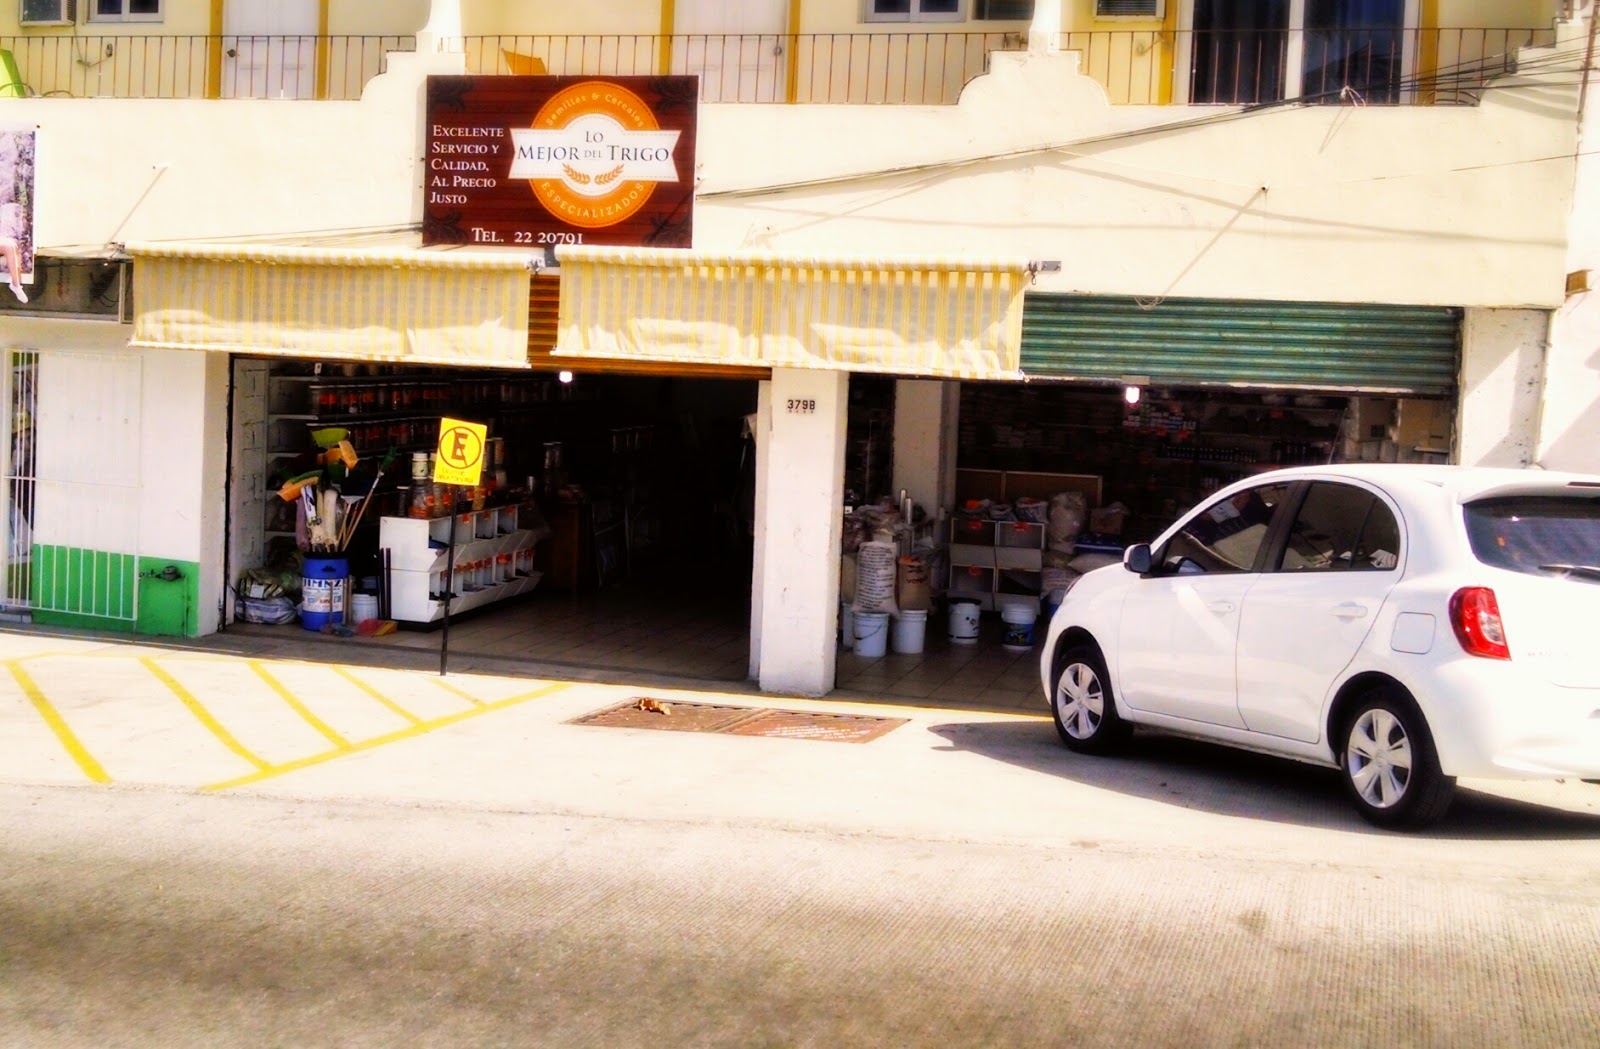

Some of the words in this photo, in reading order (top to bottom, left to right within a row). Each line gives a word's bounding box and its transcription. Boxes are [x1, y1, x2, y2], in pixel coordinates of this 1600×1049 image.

[546, 95, 587, 126] Semillas
[591, 92, 601, 101] &
[605, 94, 645, 127] Cereales
[432, 124, 505, 137] EXCELENTE
[585, 131, 604, 143] LO
[431, 141, 488, 154] SERVICIO
[491, 144, 500, 154] Y
[516, 144, 580, 163] MEJOR
[584, 149, 603, 159] DEL
[606, 144, 670, 162] TRIGO
[431, 158, 490, 172] CALIDAD,
[430, 175, 450, 187] AL
[452, 175, 497, 188] PRECIO
[430, 191, 468, 204] JUSTO
[541, 181, 645, 219] ESPECIALIZADOS
[471, 227, 505, 243] TEL.
[514, 231, 533, 243] 22
[537, 232, 583, 245] 20791
